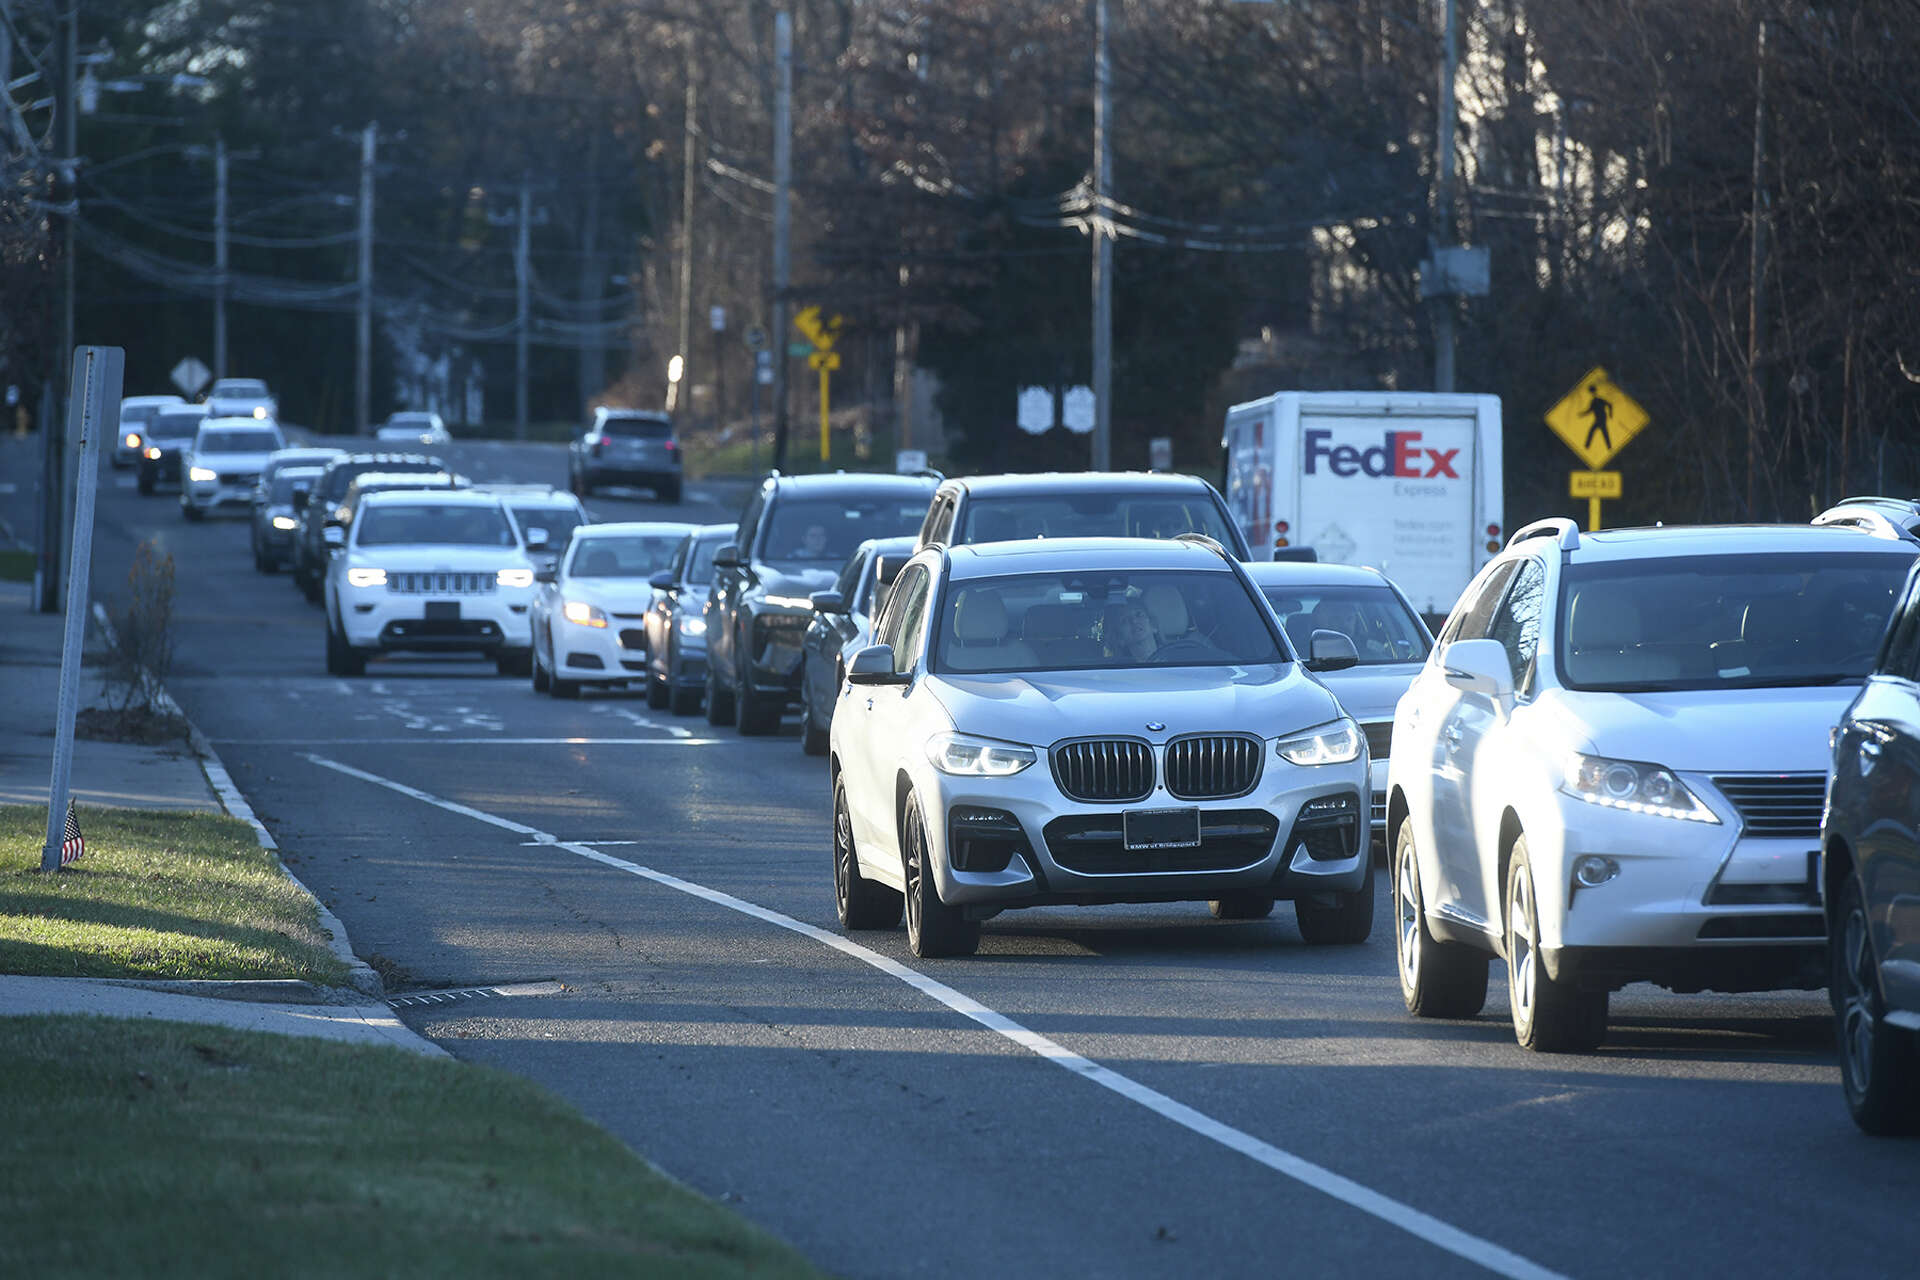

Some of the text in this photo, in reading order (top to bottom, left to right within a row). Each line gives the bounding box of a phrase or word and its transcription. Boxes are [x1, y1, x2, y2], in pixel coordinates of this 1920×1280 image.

[1305, 428, 1460, 479] FedEx
[1394, 481, 1448, 498] Express
[1578, 477, 1615, 489] AHEAD
